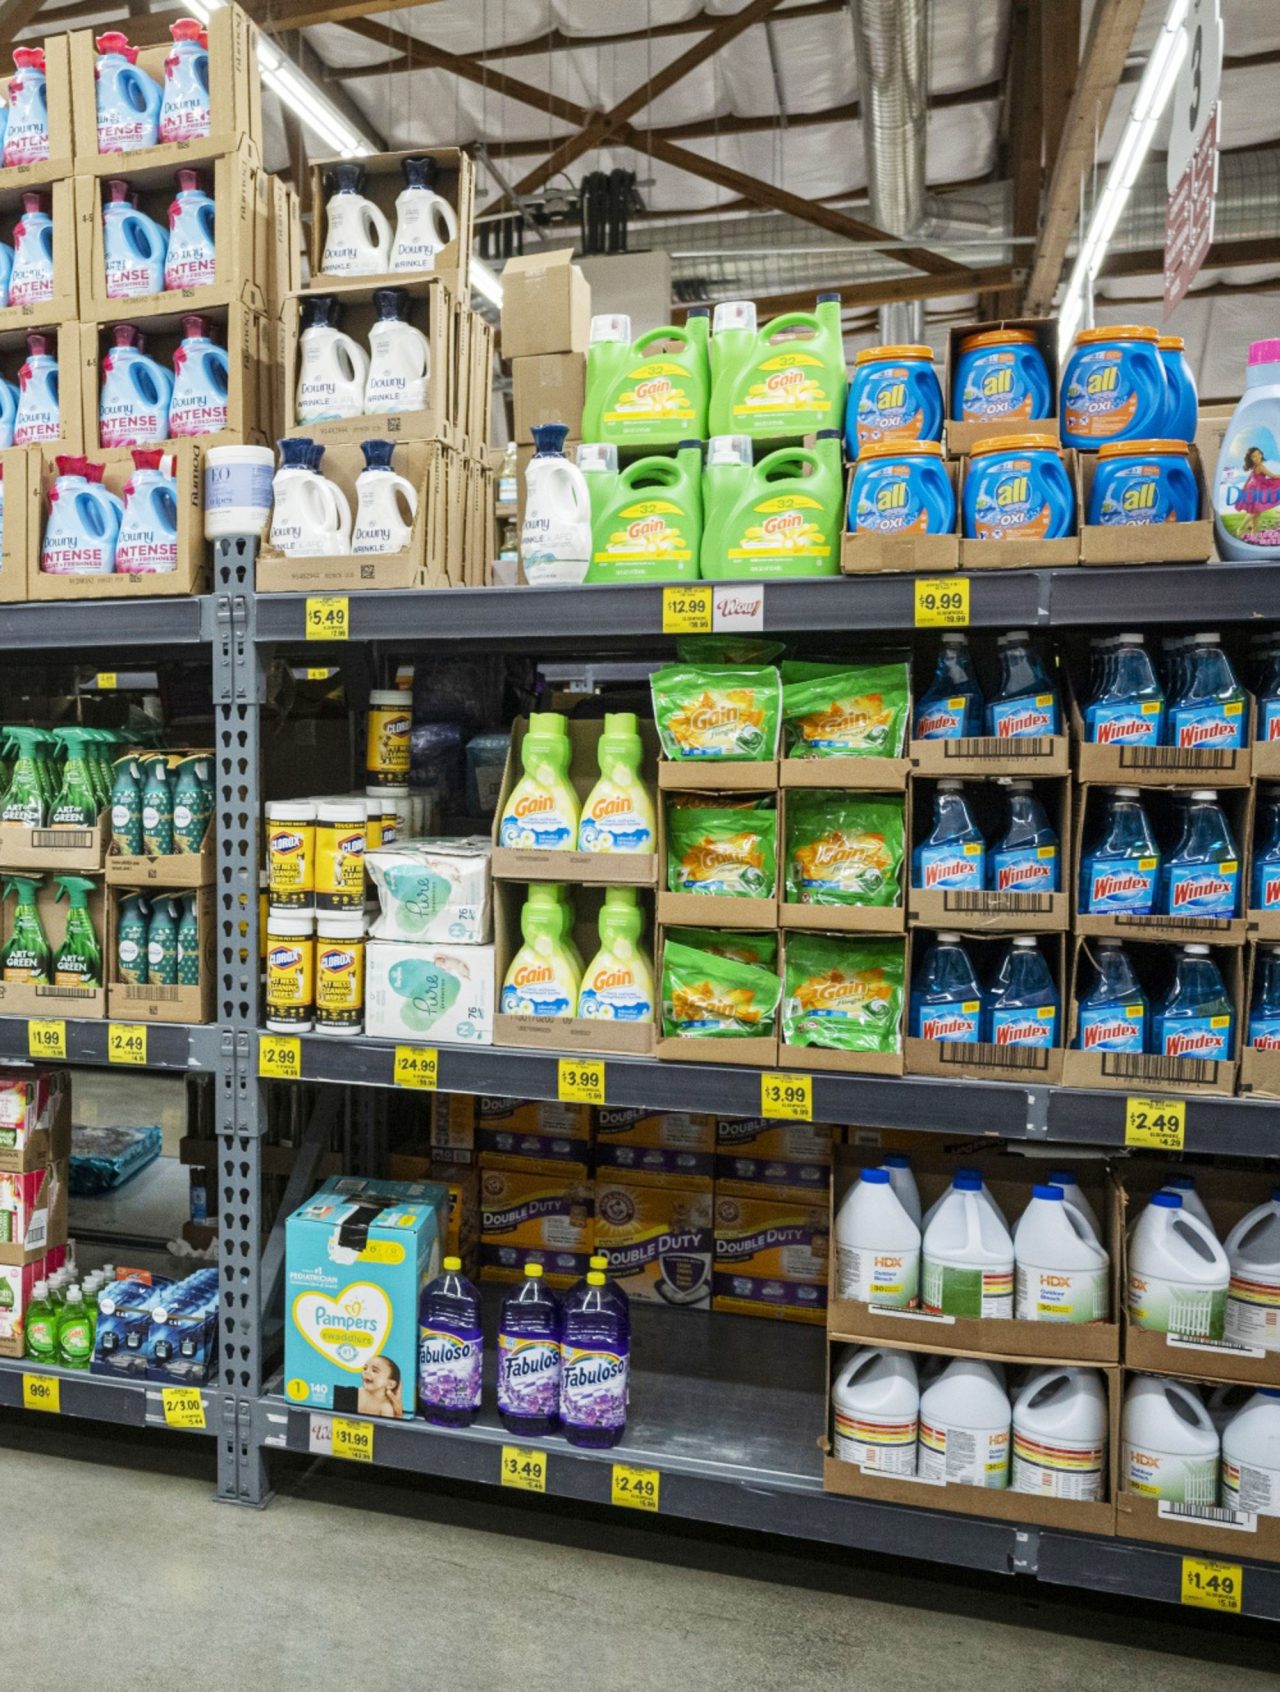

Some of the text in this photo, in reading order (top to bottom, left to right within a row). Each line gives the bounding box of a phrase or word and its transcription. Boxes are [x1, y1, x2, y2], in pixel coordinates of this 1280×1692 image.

[324, 248, 357, 259] Downy
[399, 243, 433, 256] Downy
[370, 377, 406, 389] Downy
[767, 370, 805, 391] Gain
[984, 368, 1012, 396] all
[1087, 365, 1118, 394] all
[302, 383, 336, 395] Downy
[635, 380, 671, 399] Gain
[876, 386, 905, 410] all
[1087, 400, 1112, 412] OXI
[986, 401, 1011, 414] OXI
[879, 416, 901, 428] OXI
[877, 482, 906, 511] all
[997, 476, 1028, 507] all
[1123, 481, 1156, 512] all
[640, 504, 656, 514] 32
[777, 499, 795, 509] 32
[764, 514, 803, 534] Gain
[1000, 512, 1025, 526] OXI
[356, 528, 391, 541] Downy
[628, 518, 664, 539] Gain
[42, 549, 102, 563] INTENSE
[668, 600, 706, 614] $12.99
[919, 593, 963, 611] $9.99
[308, 608, 345, 626] $5.49
[691, 704, 739, 732] Gain
[998, 713, 1050, 737] Windex
[1098, 720, 1154, 744] Windex
[1180, 722, 1236, 748] Windex
[7, 804, 23, 812] ART
[56, 806, 74, 814] ART
[514, 796, 554, 817] Gain
[592, 797, 633, 820] Gain
[2, 811, 30, 820] GREEN
[53, 813, 83, 822] GREEN
[272, 836, 299, 850] CLOROX
[926, 862, 977, 886] Windex
[998, 866, 1050, 889] Windex
[1093, 876, 1150, 900] Windex
[1173, 881, 1231, 906] Windex
[458, 908, 469, 920] 76
[6, 958, 37, 967] GREEN
[57, 962, 87, 972] GREEN
[320, 955, 351, 967] CLOROX
[514, 966, 553, 987] Gain
[593, 969, 632, 991] Gain
[413, 974, 438, 1016] Pure
[468, 1007, 478, 1018] 76
[33, 1030, 60, 1046] $1.99
[923, 1019, 974, 1042] Windex
[996, 1024, 1048, 1046] Windex
[1084, 1024, 1139, 1049] Windex
[111, 1035, 144, 1051] $2.49
[262, 1049, 296, 1064] $2.99
[398, 1058, 437, 1073] $24.99
[562, 1071, 600, 1088] $3.99
[765, 1086, 806, 1103] $3.99
[1130, 1112, 1180, 1133] $2.49
[483, 1199, 562, 1227] DOUBLE DUTY
[716, 1228, 803, 1253] DOUBLE DUTY
[874, 1256, 902, 1268] HDX
[1040, 1275, 1072, 1288] HDX
[315, 1306, 378, 1332] Pampers
[564, 1359, 624, 1389] Fabuloso
[295, 1381, 301, 1394] 1
[310, 1382, 328, 1394] 140
[167, 1400, 200, 1412] 2/3.00
[336, 1430, 369, 1446] $31.99
[503, 1459, 542, 1478] $3.49
[1130, 1453, 1160, 1468] HDX
[615, 1475, 655, 1497] $2.49
[1187, 1571, 1234, 1594] $1.49
